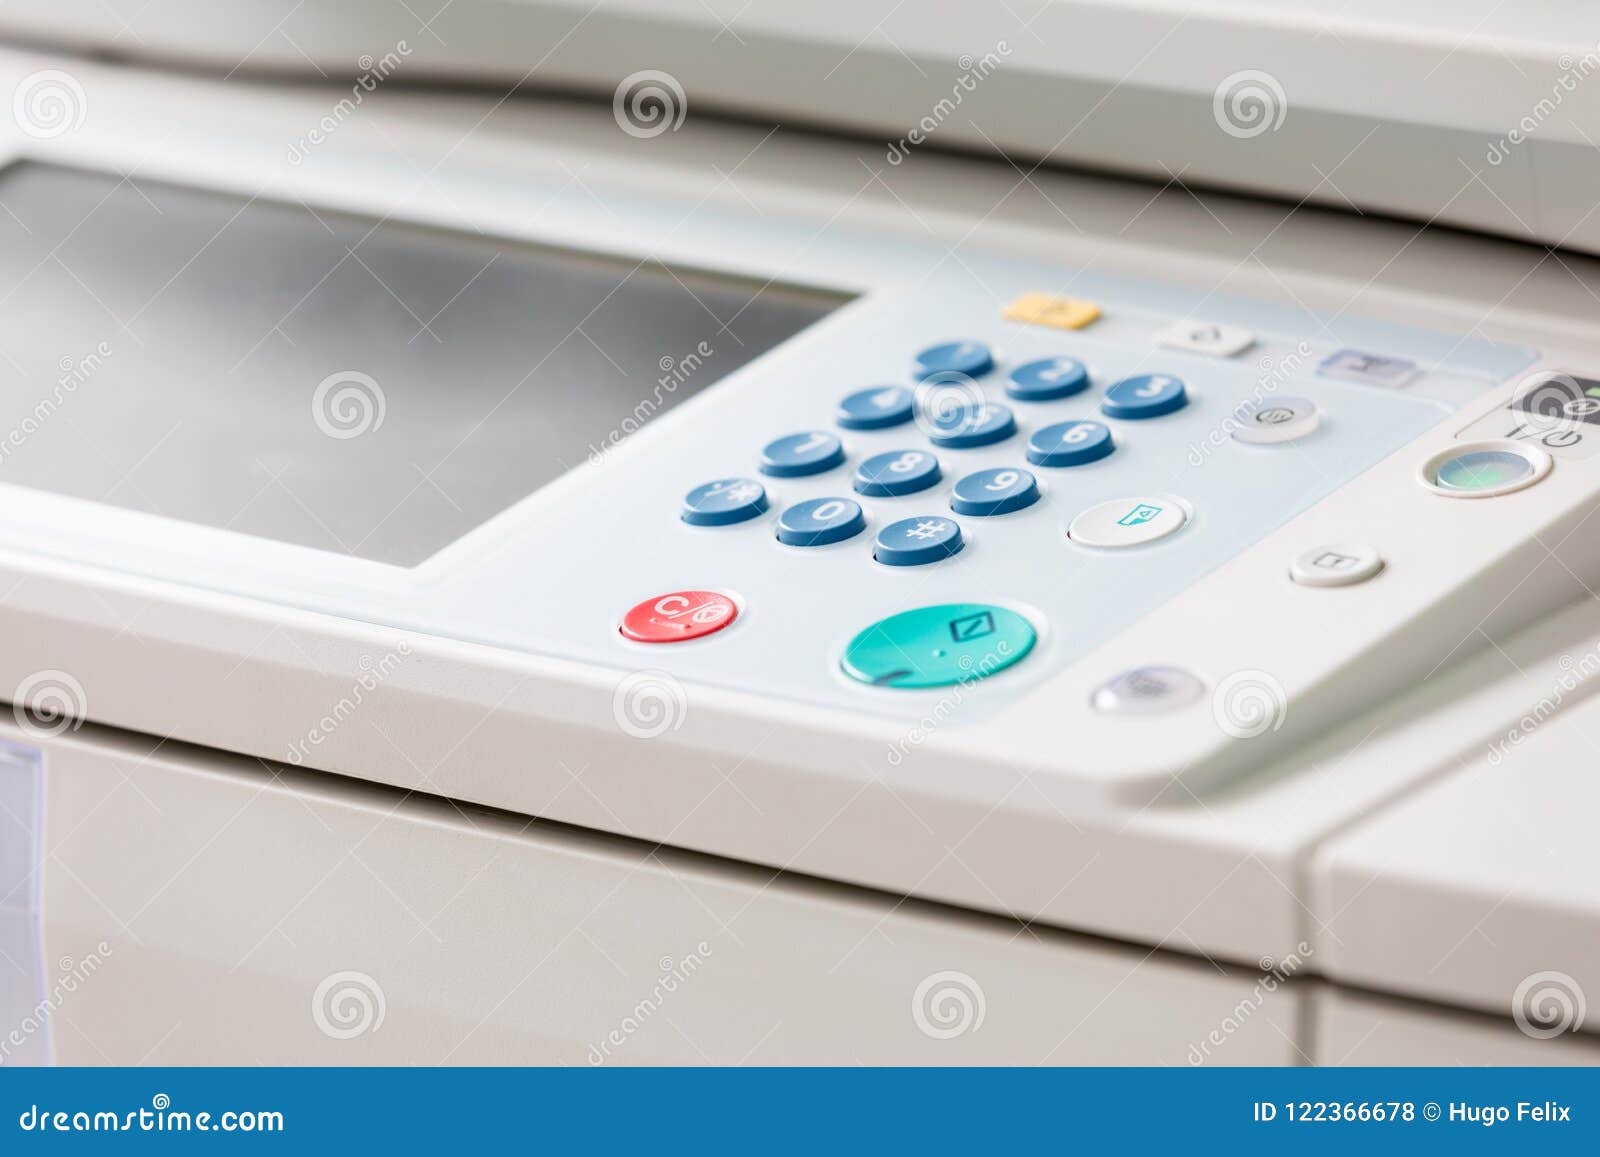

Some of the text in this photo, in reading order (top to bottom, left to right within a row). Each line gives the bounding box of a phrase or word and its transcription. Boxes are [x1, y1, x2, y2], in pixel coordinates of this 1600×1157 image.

[1062, 423, 1097, 444] 6
[889, 452, 924, 473] 8
[985, 471, 1020, 491] 9
[812, 501, 846, 521] 0
